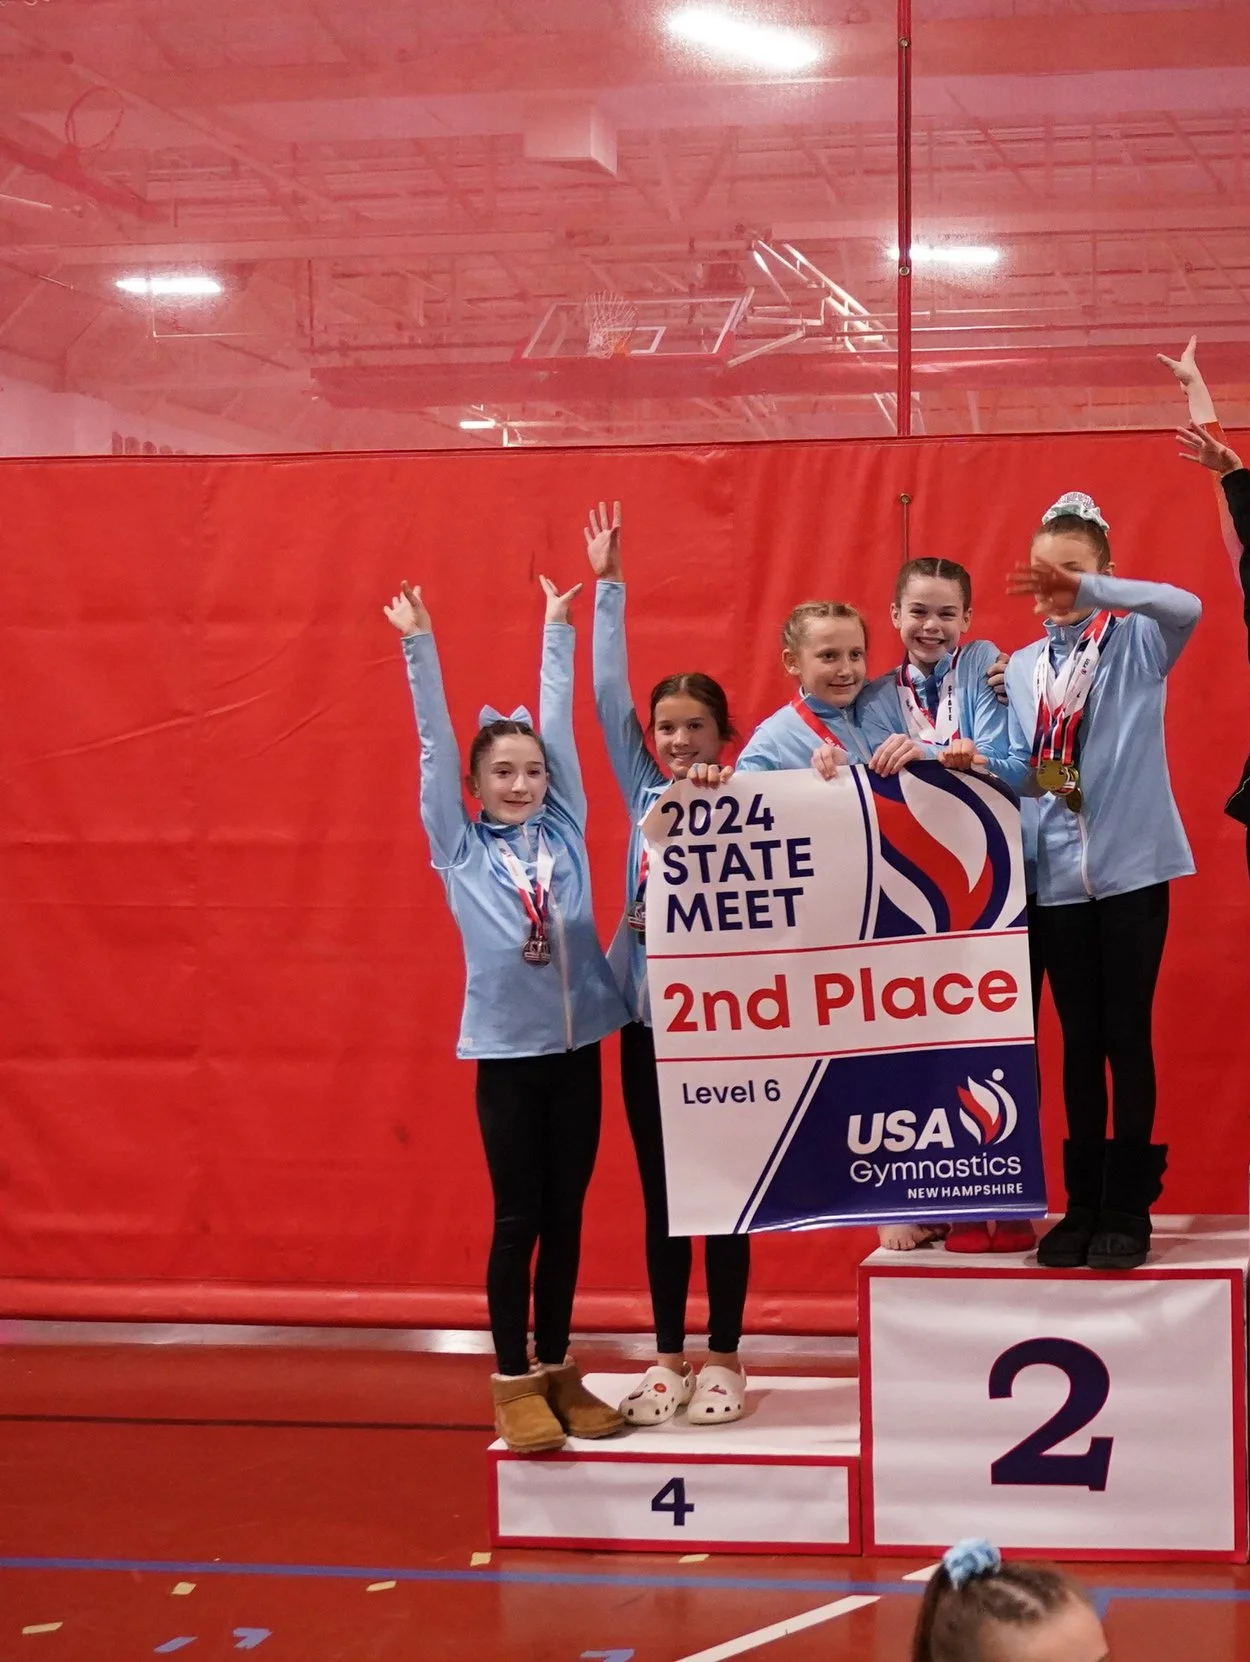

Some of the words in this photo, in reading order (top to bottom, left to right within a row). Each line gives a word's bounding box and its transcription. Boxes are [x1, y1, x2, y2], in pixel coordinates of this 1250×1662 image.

[661, 794, 774, 837] 2024
[664, 837, 814, 885] STATE
[667, 887, 803, 933] MEET
[663, 974, 791, 1033] 2nd
[813, 967, 1018, 1027] Place
[683, 1079, 756, 1105] Level
[764, 1079, 781, 1102] 6
[847, 1108, 954, 1155] USA
[850, 1153, 1022, 1187] Gymnastics
[907, 1187, 938, 1199] NEW
[941, 1182, 1023, 1198] HAMPSHIRE
[988, 1337, 1114, 1492] 2
[651, 1477, 695, 1526] 4
